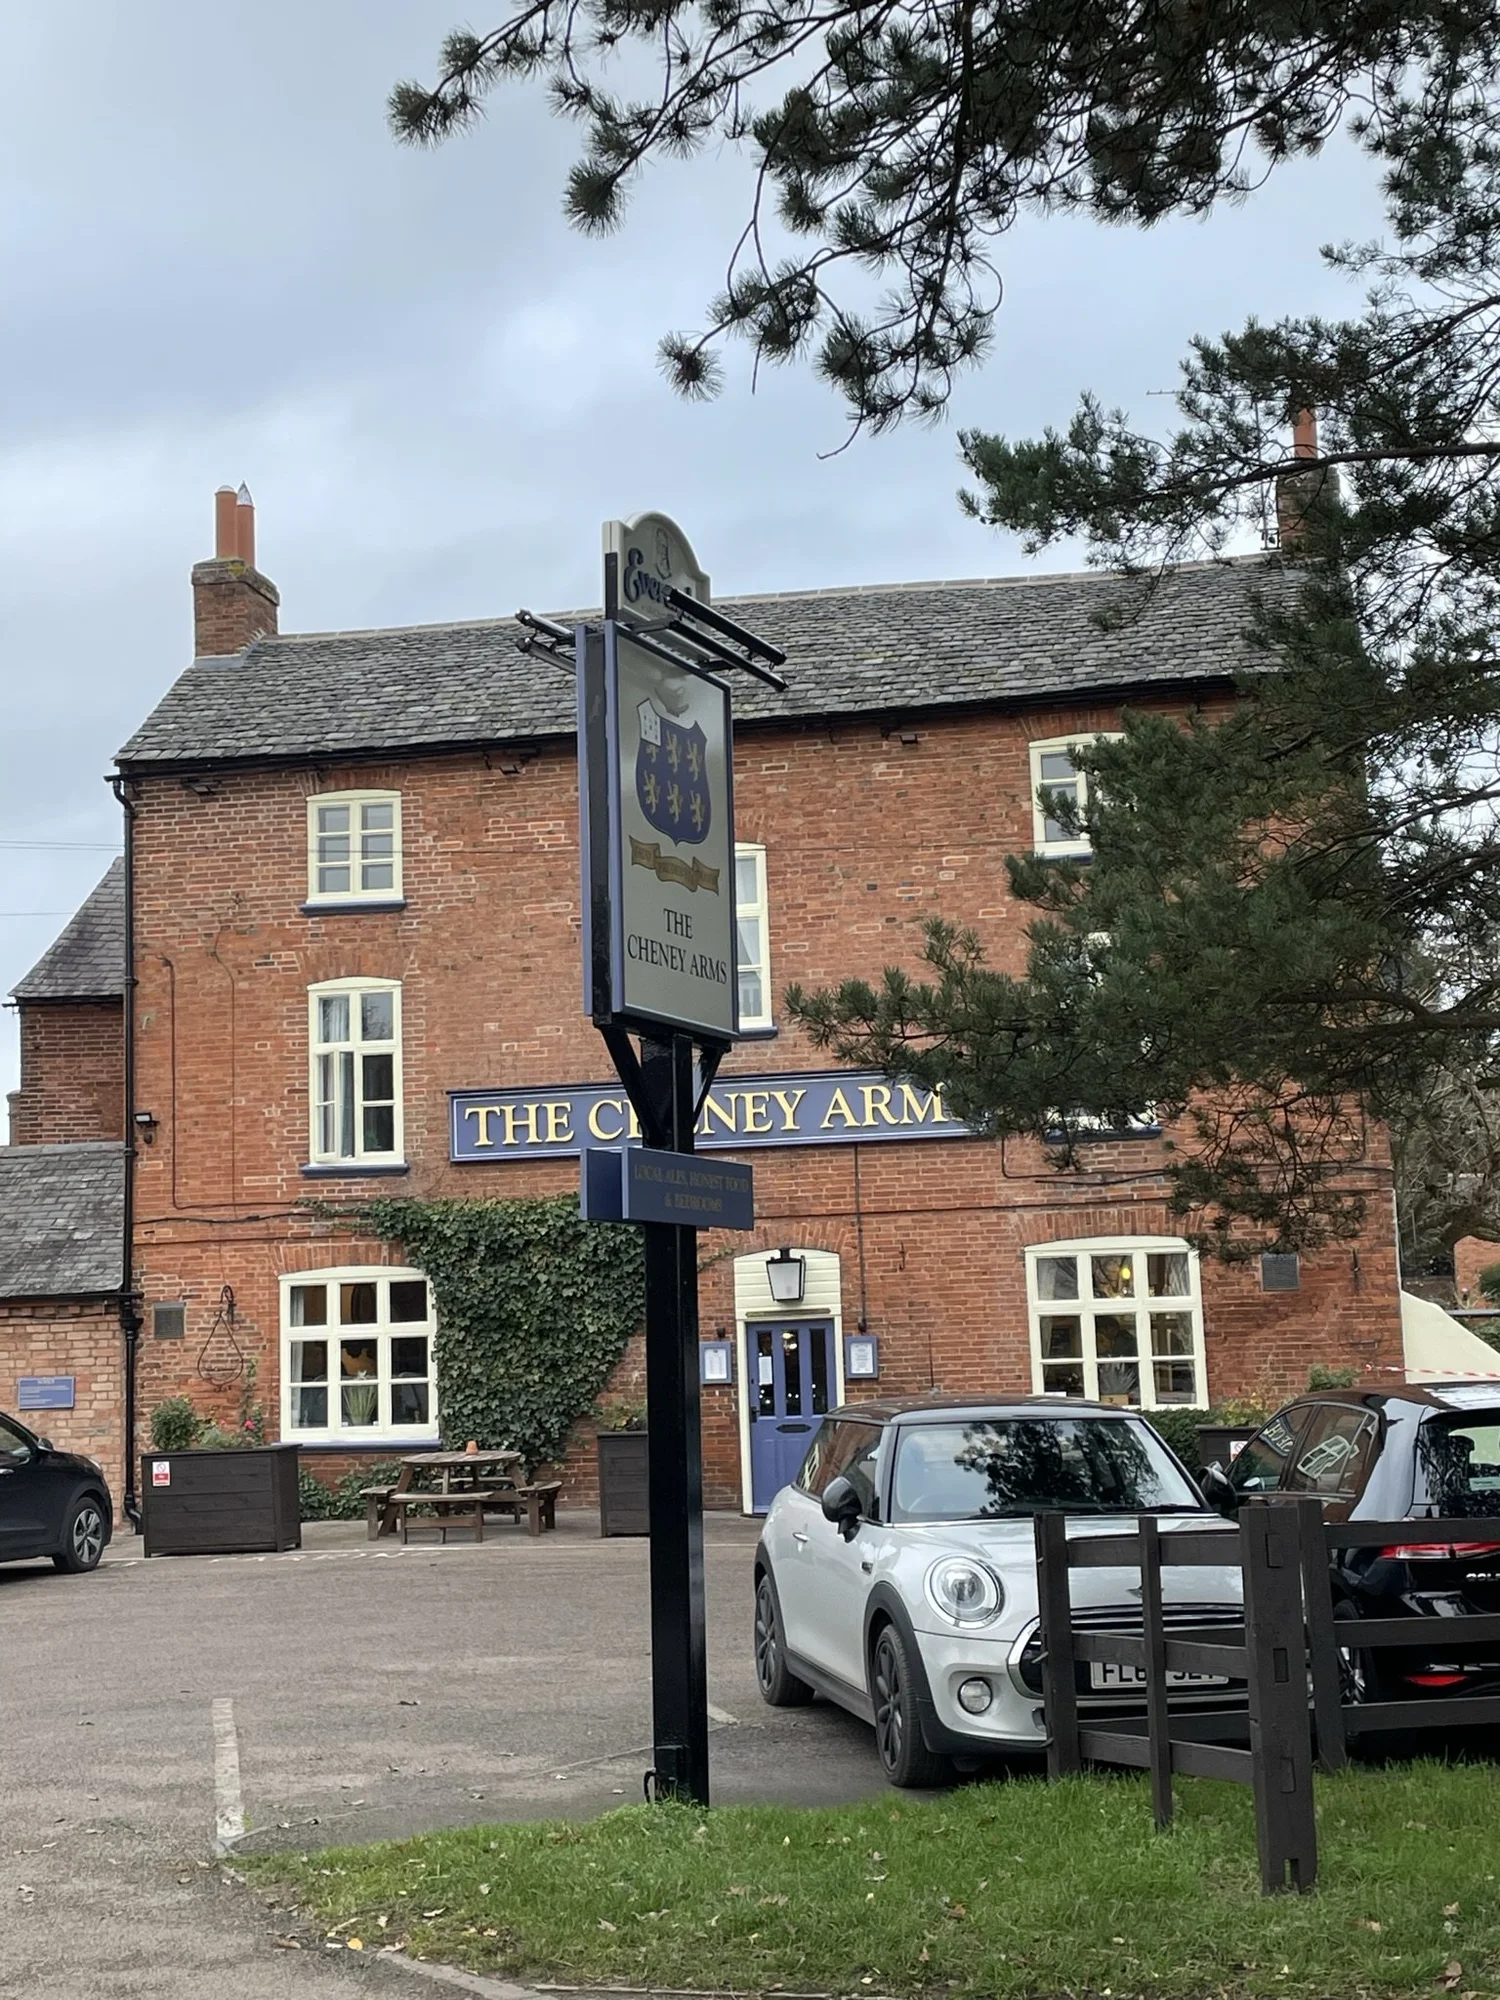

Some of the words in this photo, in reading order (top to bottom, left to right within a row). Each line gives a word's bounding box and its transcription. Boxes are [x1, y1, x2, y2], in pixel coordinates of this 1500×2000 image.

[663, 908, 693, 939] THE
[627, 934, 687, 973] CHENEY
[690, 953, 727, 984] ARMS
[465, 1102, 574, 1146] THE
[588, 1089, 807, 1140] CNEY
[820, 1082, 963, 1128] ARM
[725, 1176, 750, 1193] FOOD
